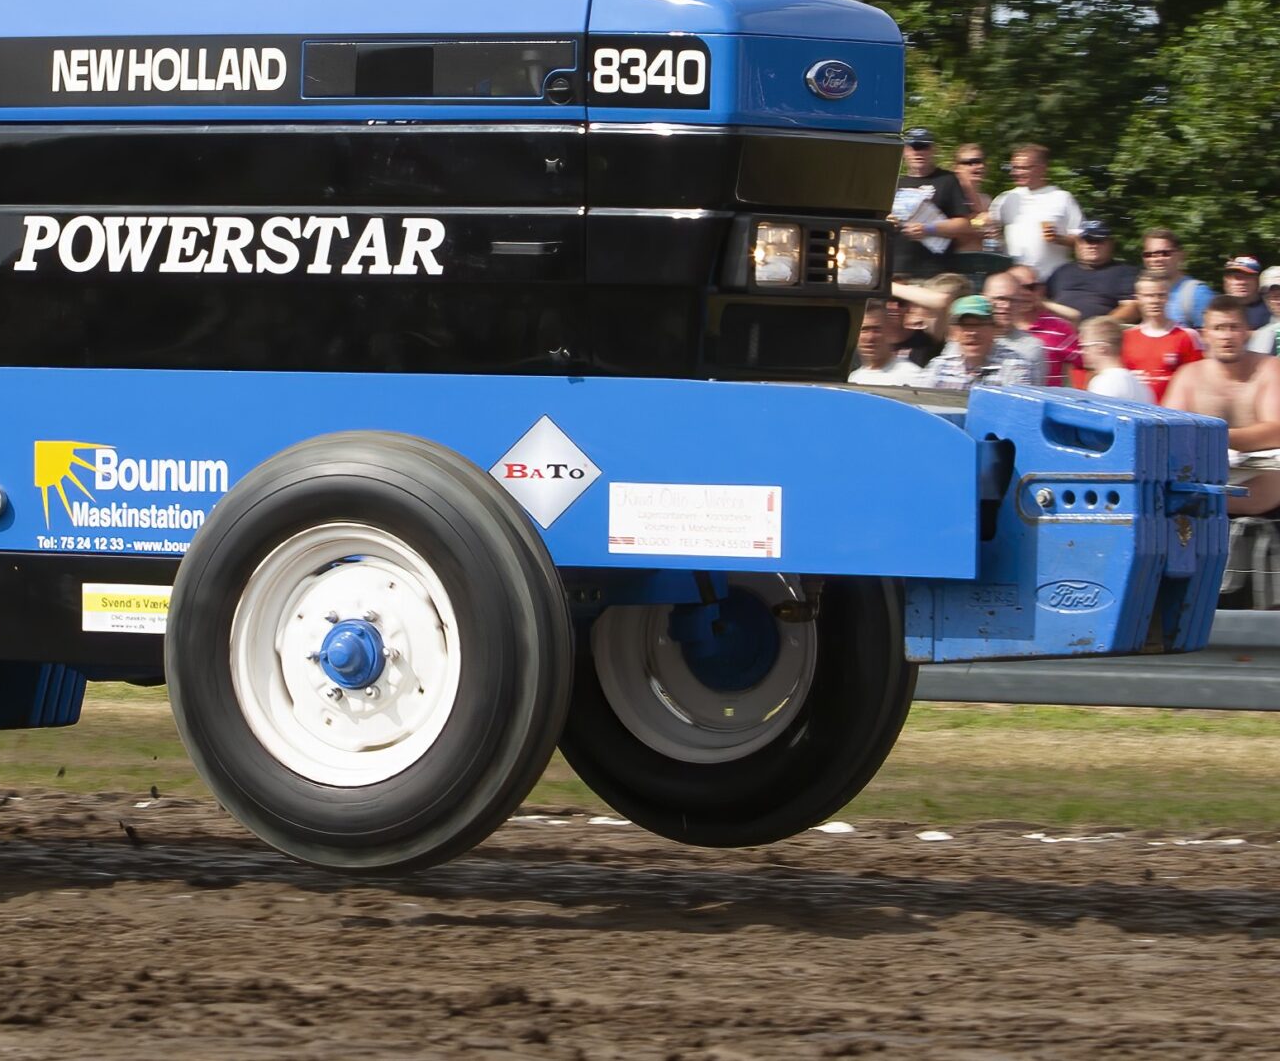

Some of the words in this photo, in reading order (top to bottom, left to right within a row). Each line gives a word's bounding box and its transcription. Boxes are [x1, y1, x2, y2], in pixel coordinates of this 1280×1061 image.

[52, 49, 124, 92] NEW
[127, 47, 287, 91] HOLLAND
[593, 48, 706, 95] 8340
[13, 215, 446, 275] POWERSTAR
[95, 448, 229, 493] Bounum
[72, 501, 205, 530] Maskinstation
[36, 536, 58, 549] Tel:
[60, 537, 75, 549] 75
[76, 538, 91, 550] 24
[94, 537, 108, 551] 12
[109, 538, 124, 551] 33
[1049, 582, 1099, 608] Ford
